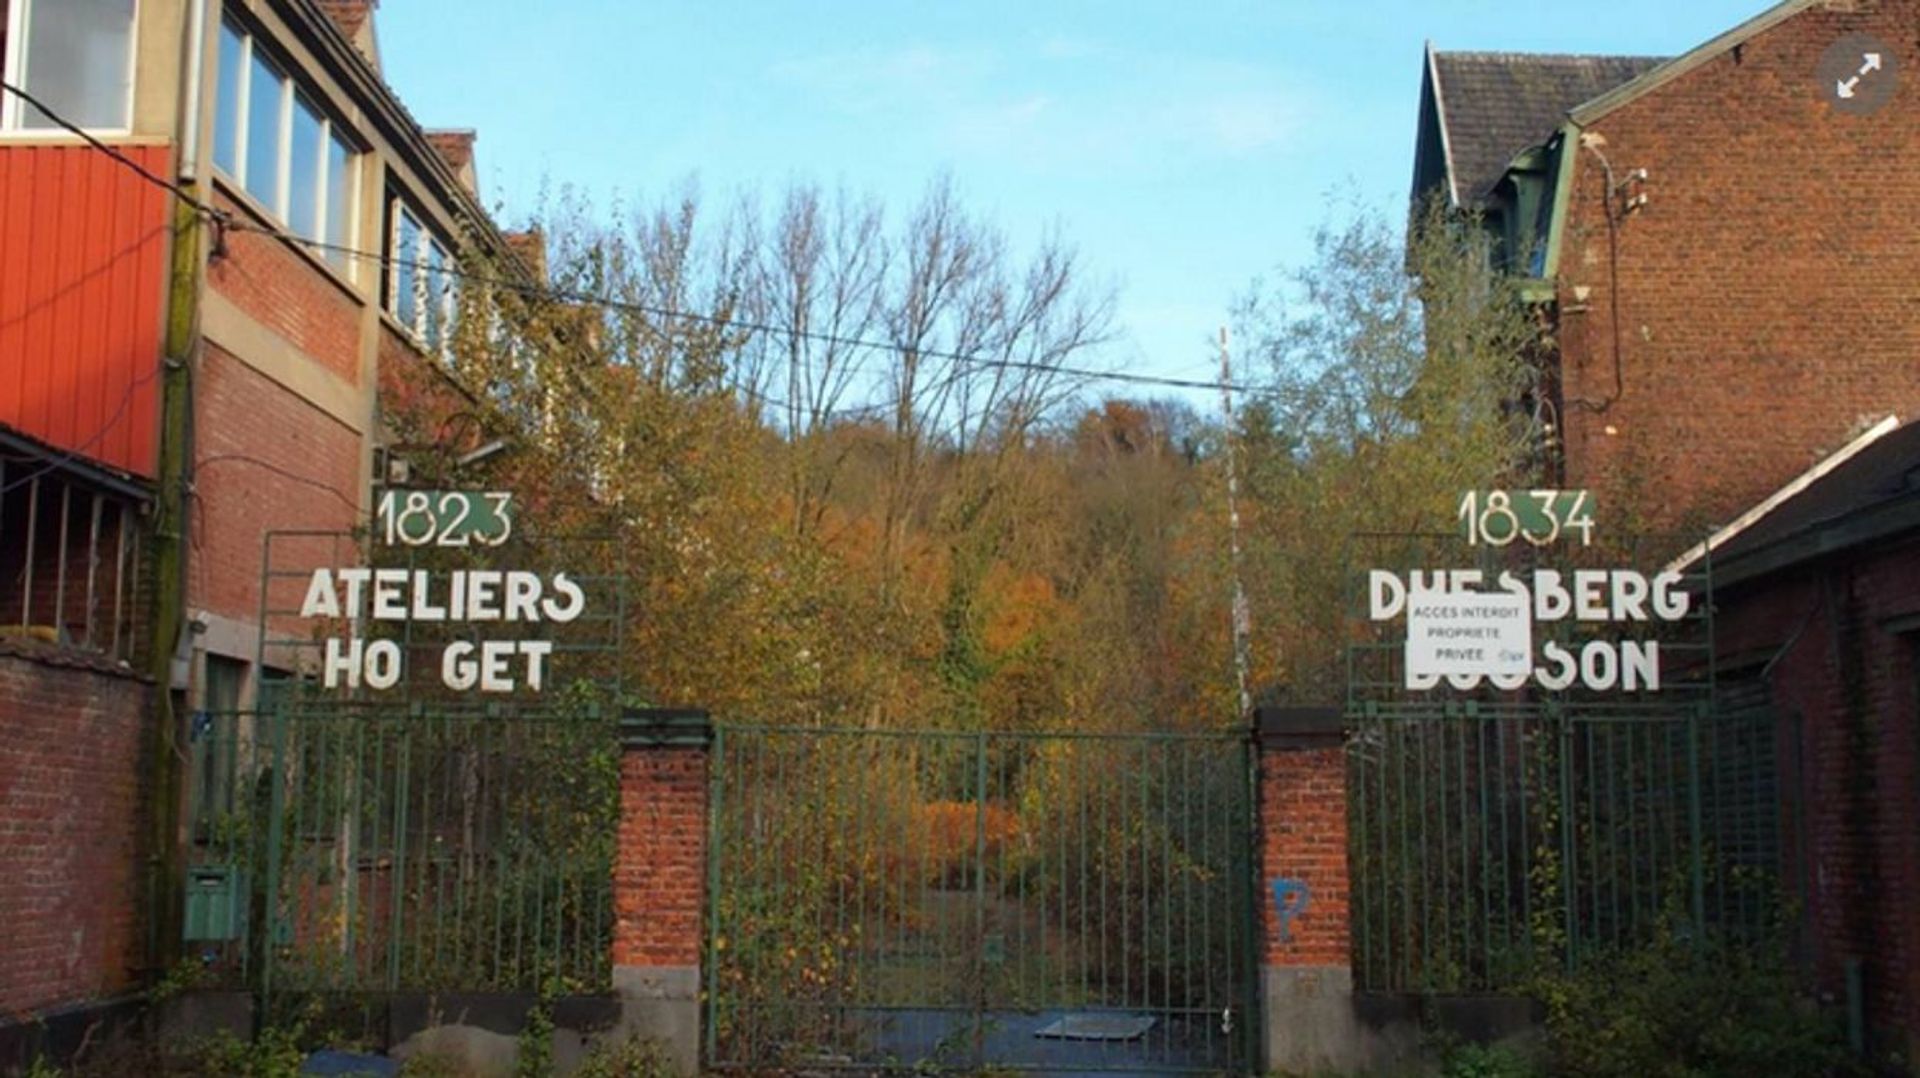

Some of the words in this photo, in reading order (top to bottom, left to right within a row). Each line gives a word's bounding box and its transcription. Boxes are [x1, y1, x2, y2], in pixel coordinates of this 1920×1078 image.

[378, 492, 512, 546] 1823
[1458, 490, 1596, 546] 1834
[301, 568, 585, 622] ATELIERS
[1414, 606, 1459, 618] ACCES
[1461, 606, 1519, 618] INTERDIT
[1427, 627, 1500, 639] PROPRIETE
[1435, 648, 1484, 660] PRIVEE
